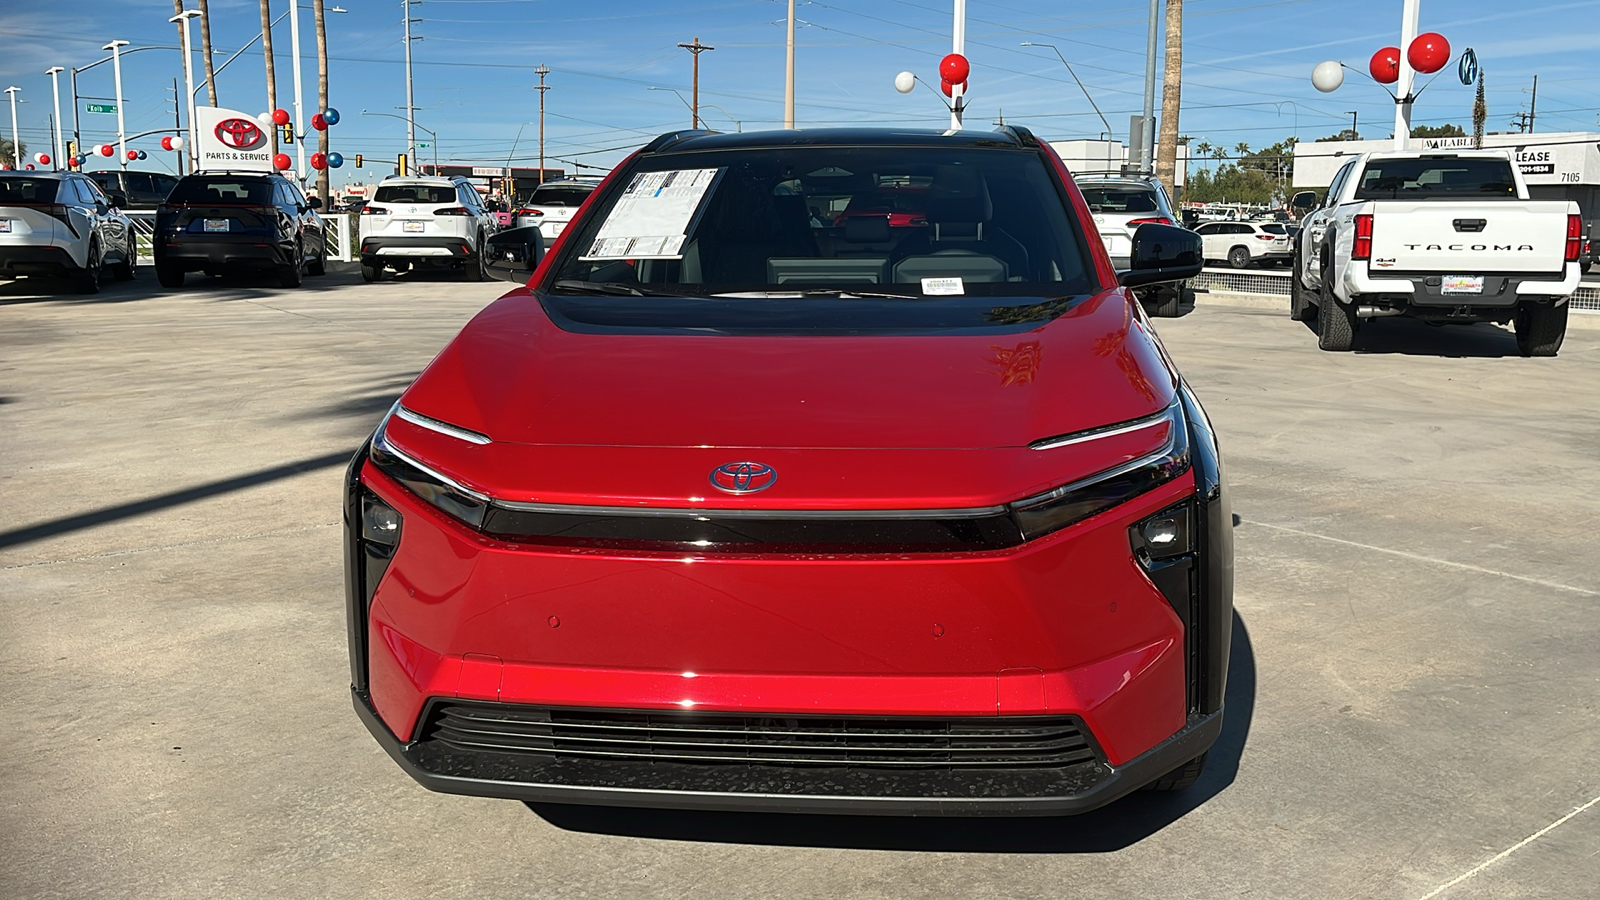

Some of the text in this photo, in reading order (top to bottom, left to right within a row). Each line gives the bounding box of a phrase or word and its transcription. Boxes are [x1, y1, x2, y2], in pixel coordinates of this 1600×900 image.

[91, 105, 103, 113] Kolb
[206, 152, 231, 160] PARTS
[240, 153, 270, 161] SERVICE
[1516, 152, 1550, 162] LEASE
[1561, 173, 1580, 182] 7105
